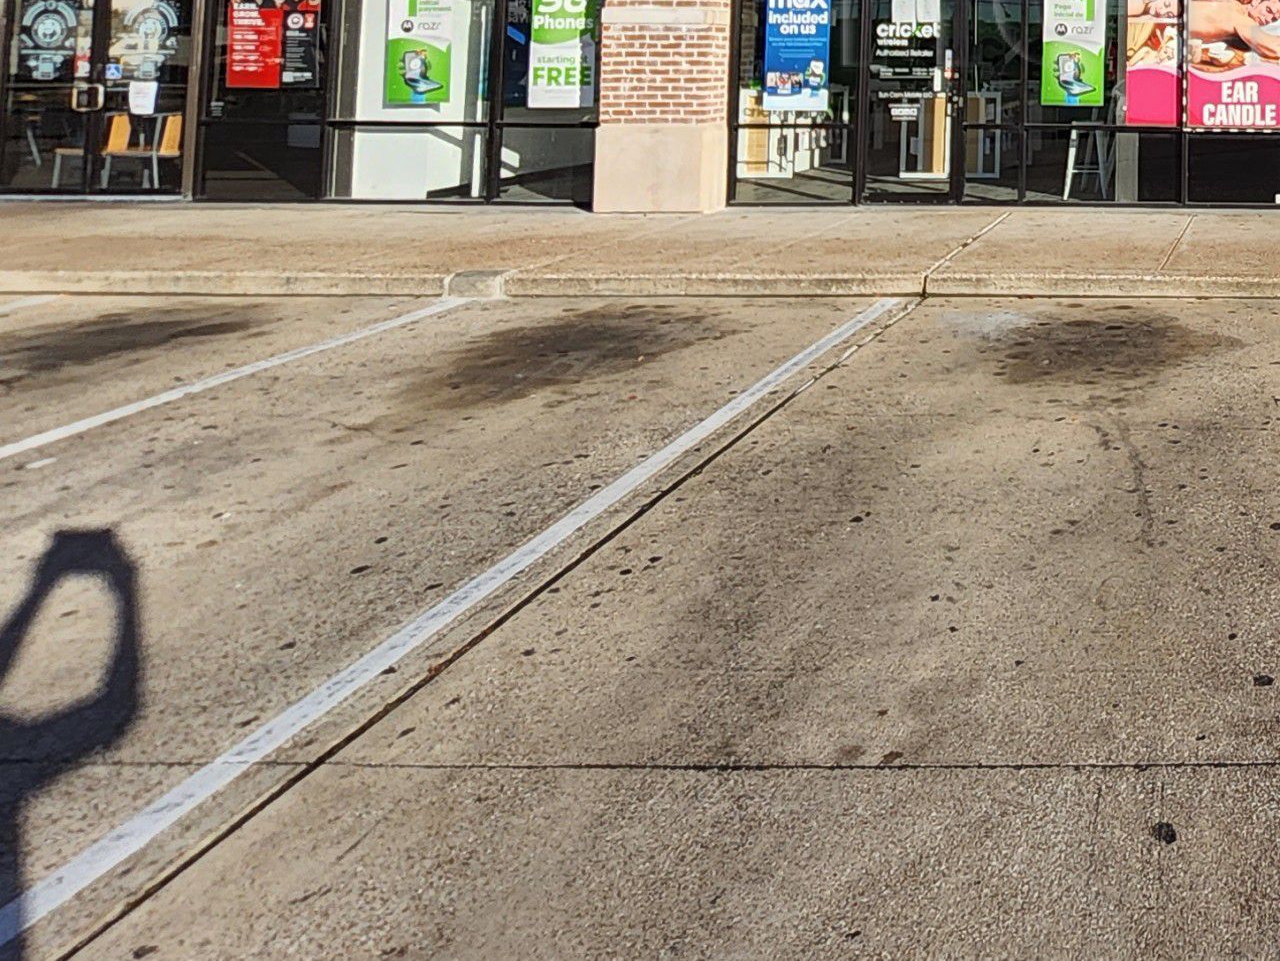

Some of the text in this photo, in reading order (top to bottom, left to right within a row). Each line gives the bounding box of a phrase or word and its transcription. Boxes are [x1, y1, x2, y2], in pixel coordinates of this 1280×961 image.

[533, 15, 594, 29] Phones
[768, 11, 828, 24] included
[780, 24, 816, 34] on us
[876, 22, 941, 38] cricket
[1071, 26, 1094, 35] razr
[537, 56, 575, 64] starting
[532, 66, 592, 87] FREE
[1221, 81, 1259, 103] EAR
[1202, 103, 1277, 126] CANDLE
